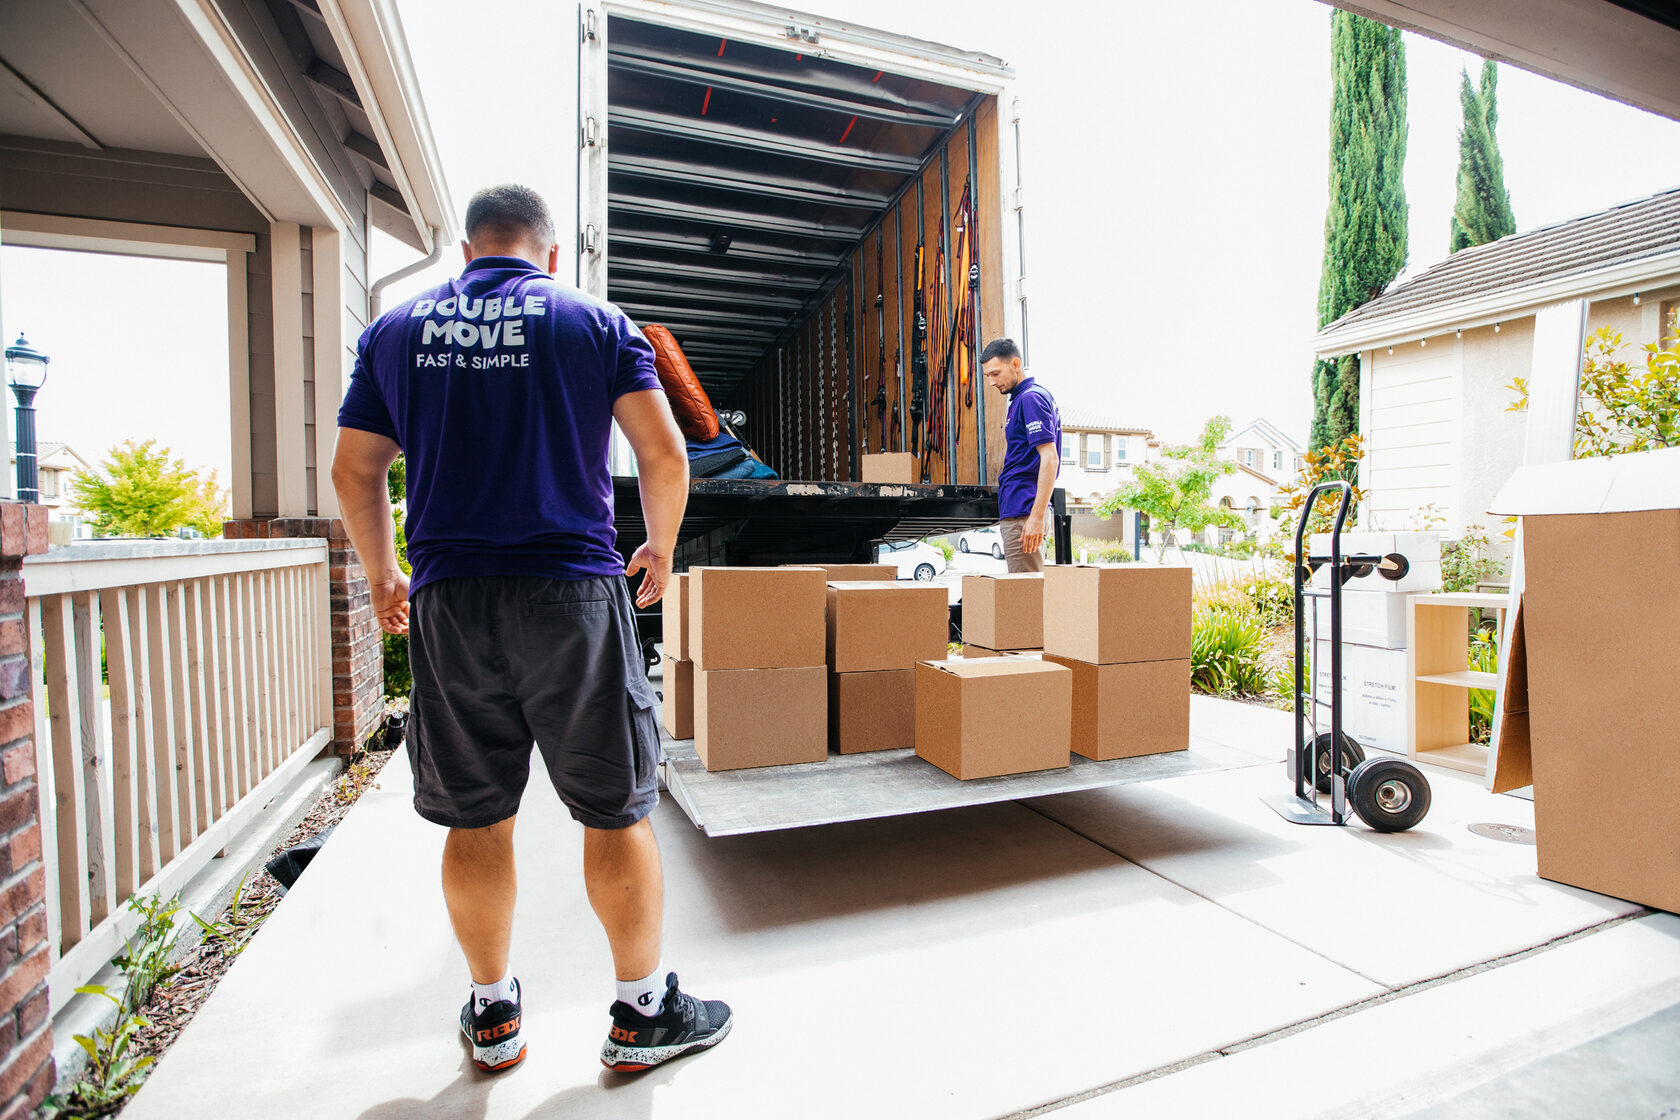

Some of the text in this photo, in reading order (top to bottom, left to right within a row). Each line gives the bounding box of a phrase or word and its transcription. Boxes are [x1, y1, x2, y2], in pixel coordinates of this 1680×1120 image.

[411, 293, 546, 321] DOUBLE
[422, 319, 525, 349] MOVE
[416, 352, 530, 370] FAST & SIMPLE
[1363, 680, 1396, 691] STRETCH FILM
[476, 1015, 521, 1042] RBX
[609, 1024, 639, 1043] BX
